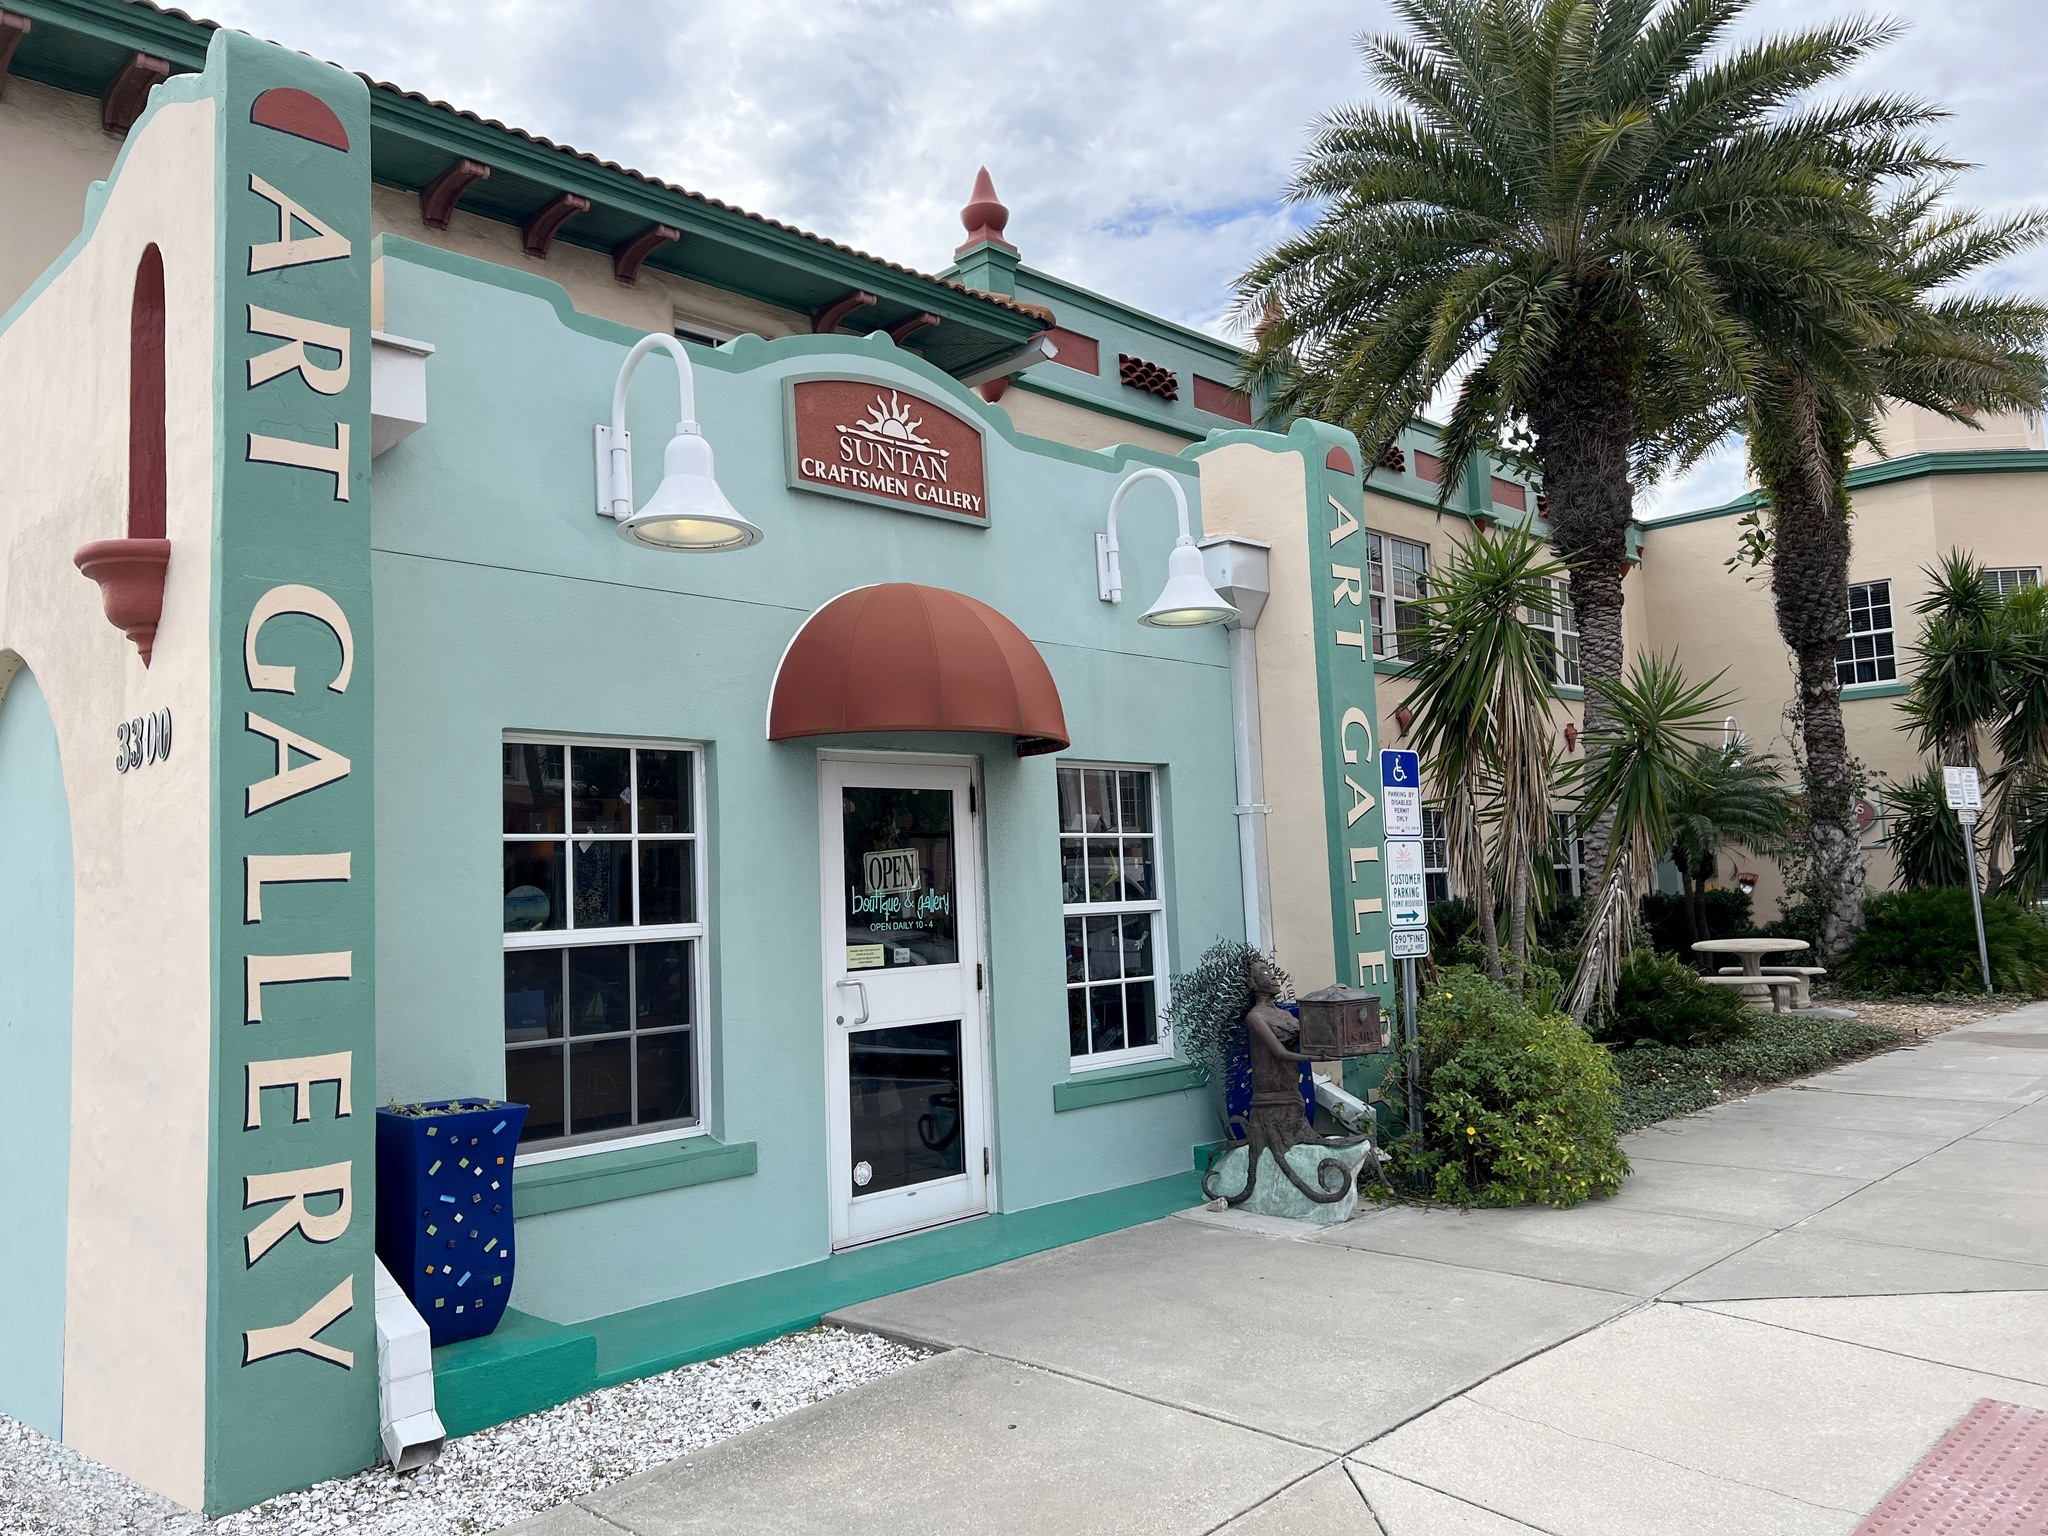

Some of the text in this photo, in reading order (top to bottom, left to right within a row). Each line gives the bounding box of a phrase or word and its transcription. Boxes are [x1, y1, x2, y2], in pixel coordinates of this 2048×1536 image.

[839, 435, 948, 483] SUNTAN
[801, 457, 982, 512] CRAFTSMEN GALLERY
[1327, 493, 1366, 662] ART
[116, 706, 172, 774] 3300
[243, 173, 354, 1369] ART GALLERY
[869, 854, 915, 890] OPEN
[1391, 874, 1421, 885] CUSTOMER
[852, 886, 950, 921] boutique & gallery
[1394, 887, 1420, 898] PARKING
[870, 922, 891, 931] OPEN
[892, 921, 913, 930] DAILY
[915, 920, 923, 929] 10
[928, 920, 933, 928] 4
[1394, 933, 1424, 944] $90 FINE
